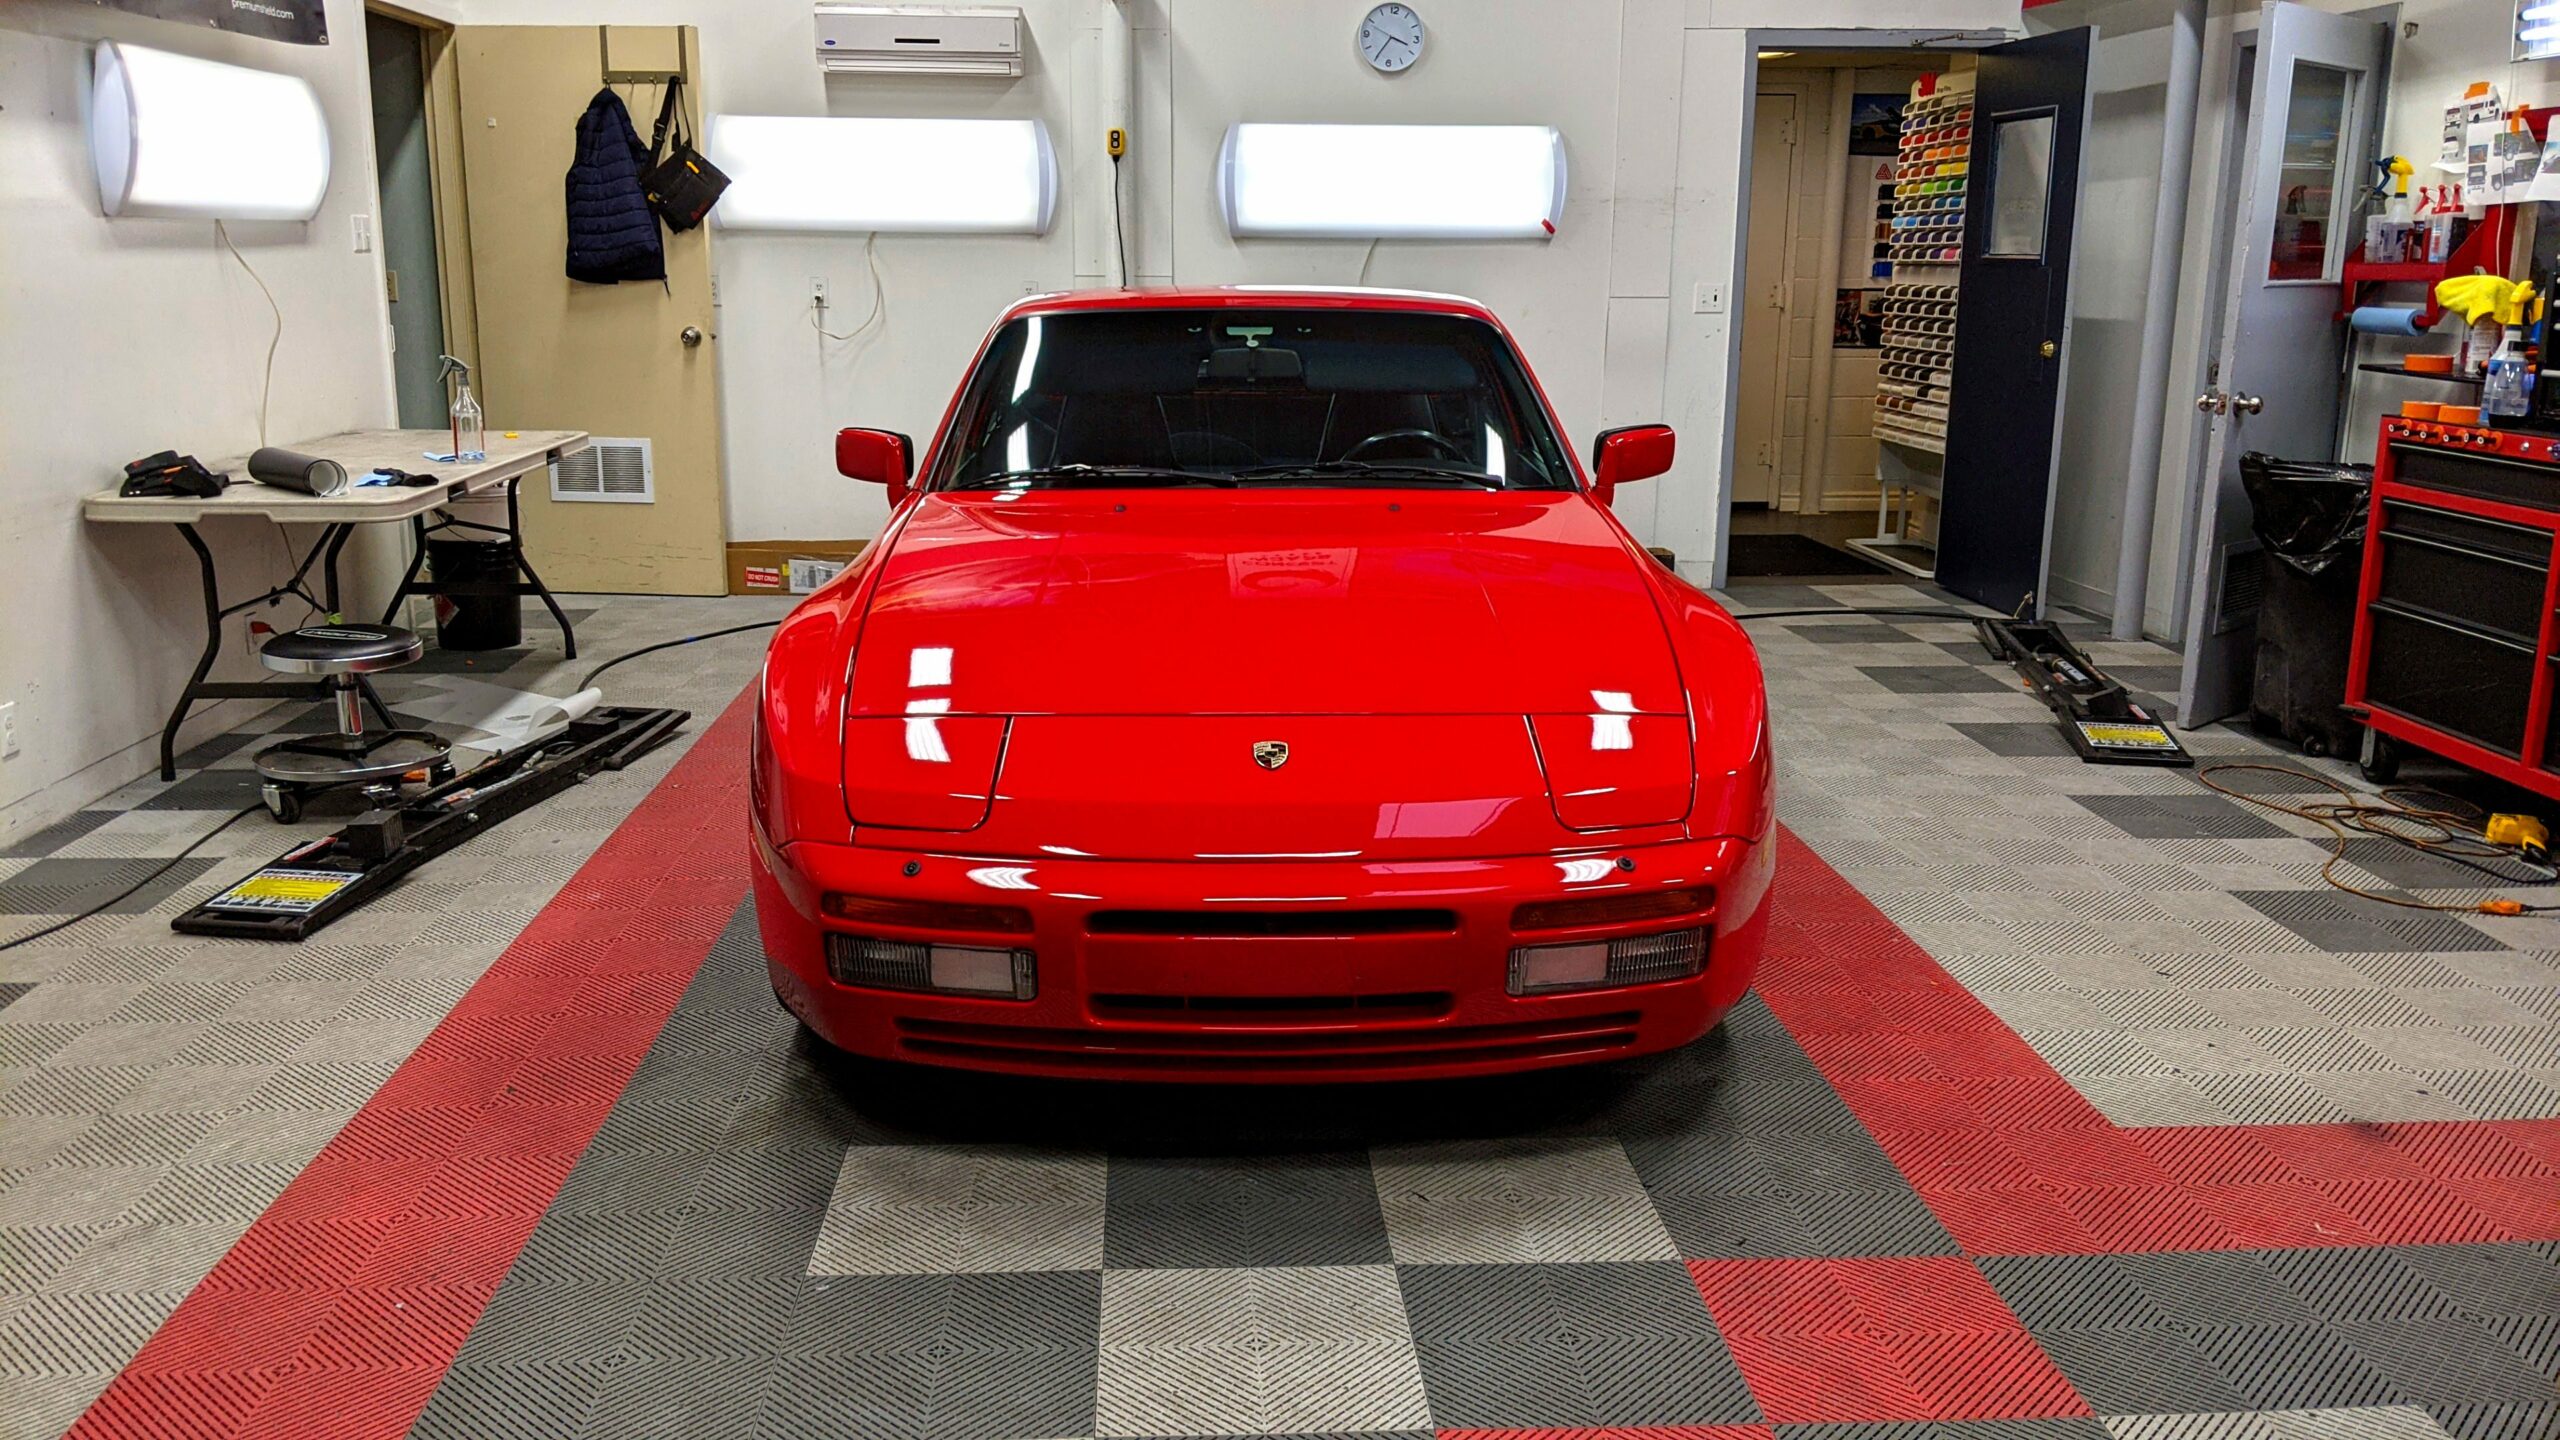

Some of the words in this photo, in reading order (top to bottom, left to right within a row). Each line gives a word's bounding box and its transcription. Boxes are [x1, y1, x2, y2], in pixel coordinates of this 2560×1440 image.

[1390, 6, 1400, 15] 12
[1363, 30, 1370, 38] 9
[1412, 36, 1420, 44] 3
[1385, 59, 1392, 67] 6
[1918, 71, 1937, 97] 3M
